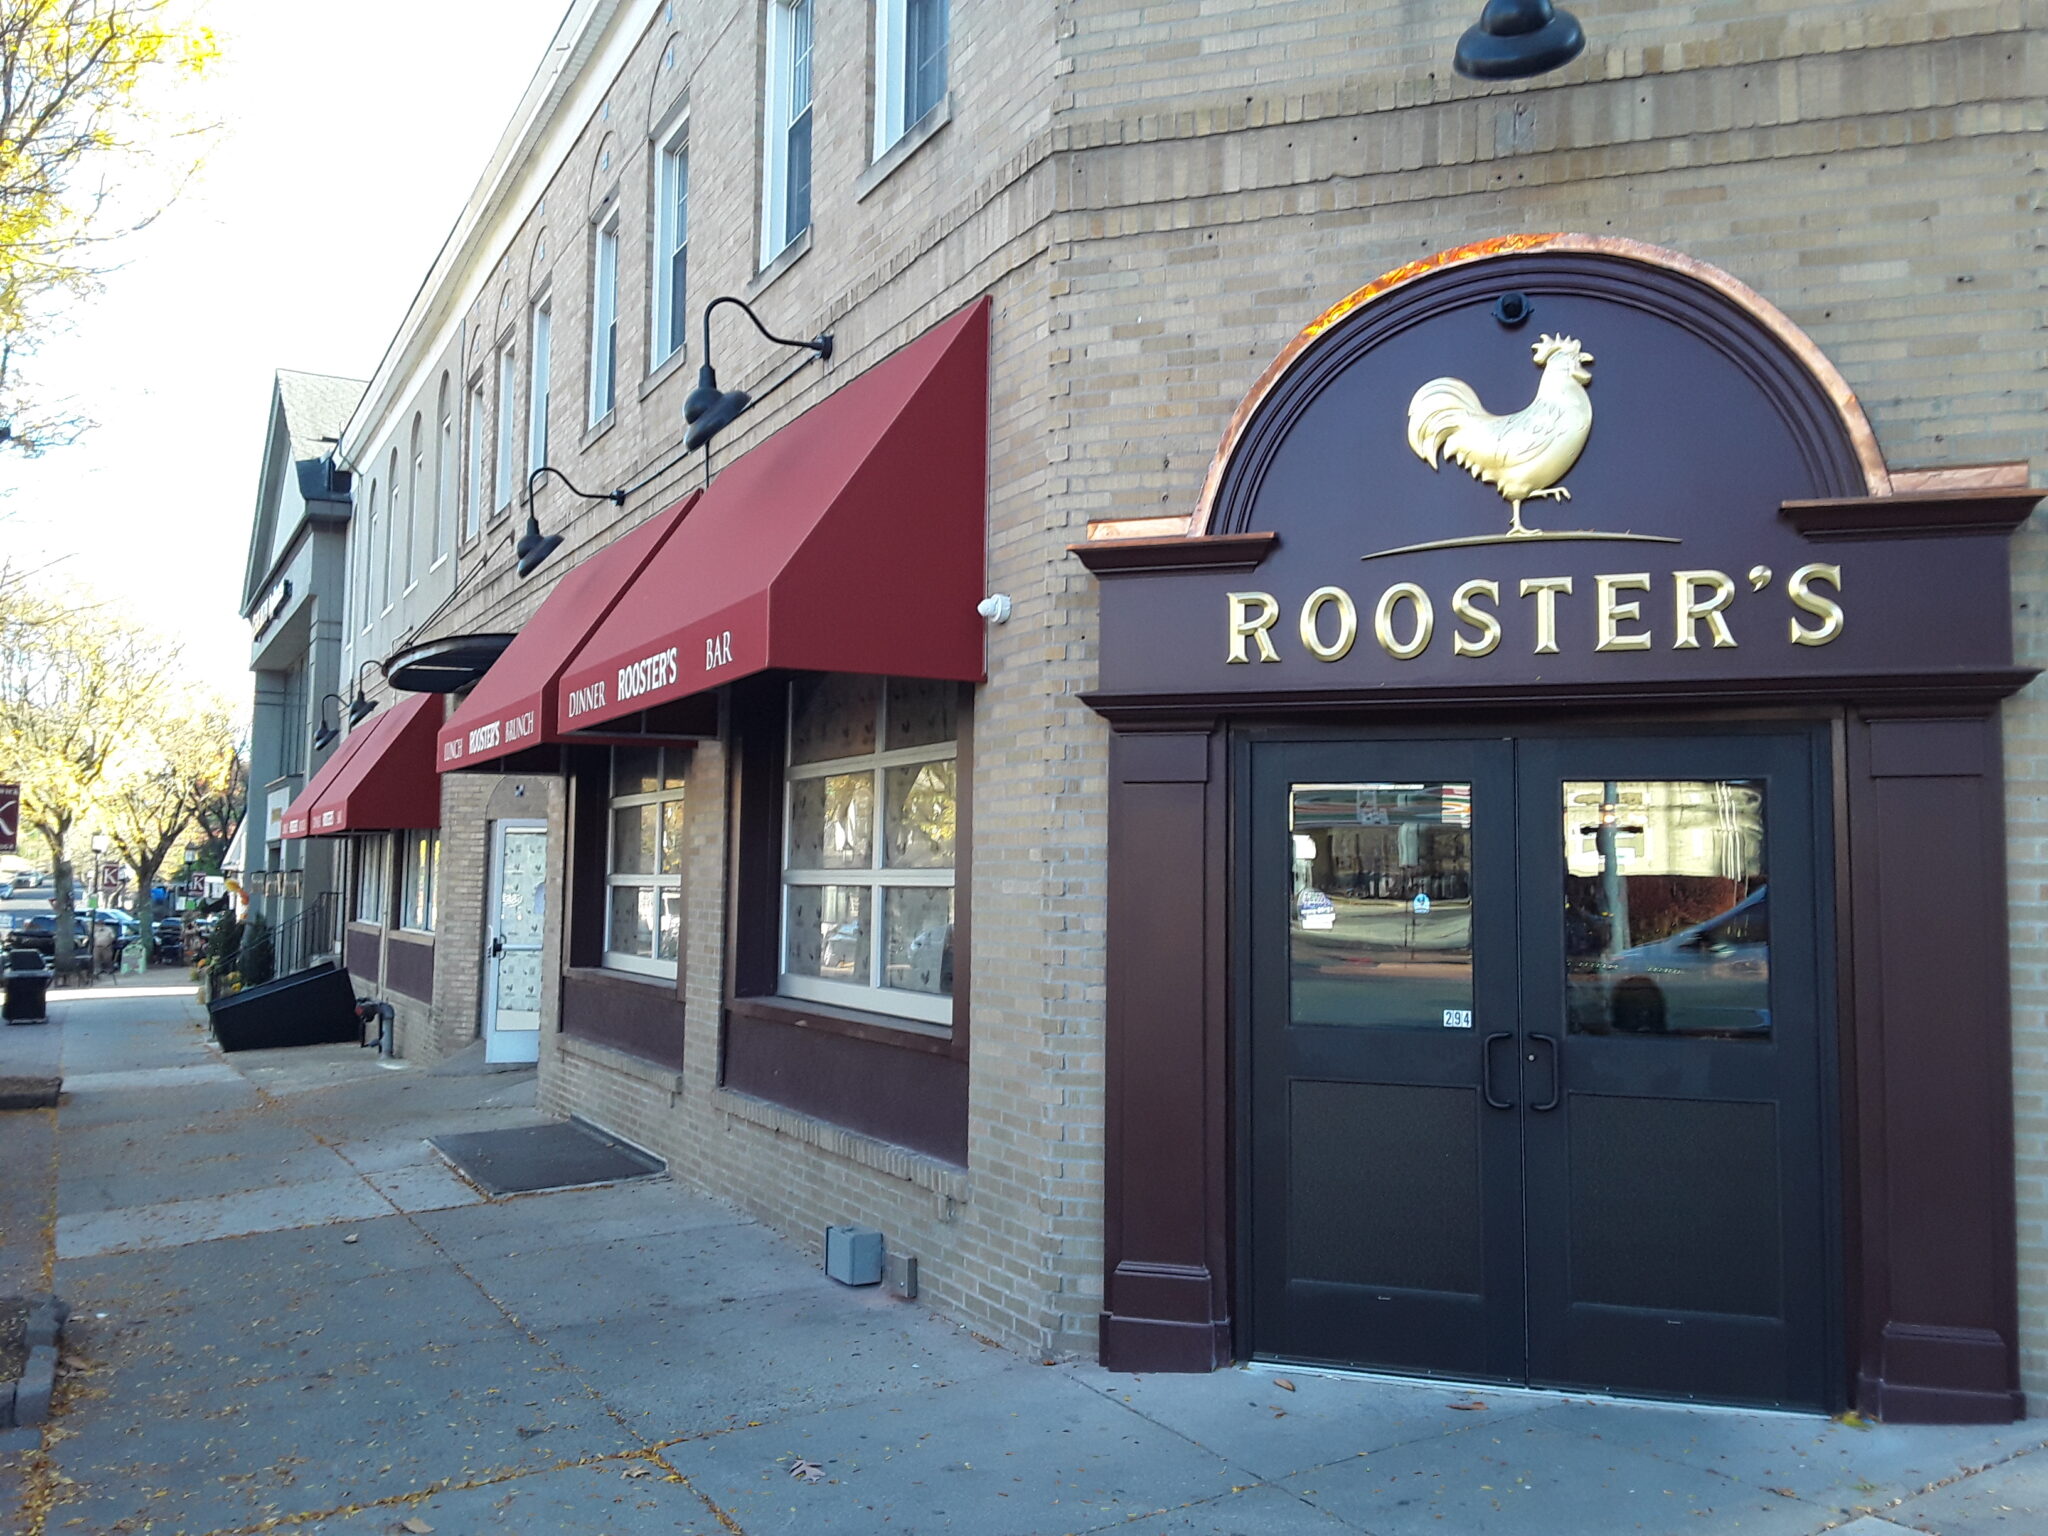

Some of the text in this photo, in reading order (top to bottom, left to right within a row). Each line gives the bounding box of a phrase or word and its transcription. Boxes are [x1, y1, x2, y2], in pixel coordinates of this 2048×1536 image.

[1226, 563, 1845, 664] ROOSTER'S
[568, 630, 733, 718] DINNER ROOSTER'S BAR
[468, 719, 501, 755] ROOSTER'S
[103, 867, 118, 886] K
[1445, 1011, 1470, 1027] 294
